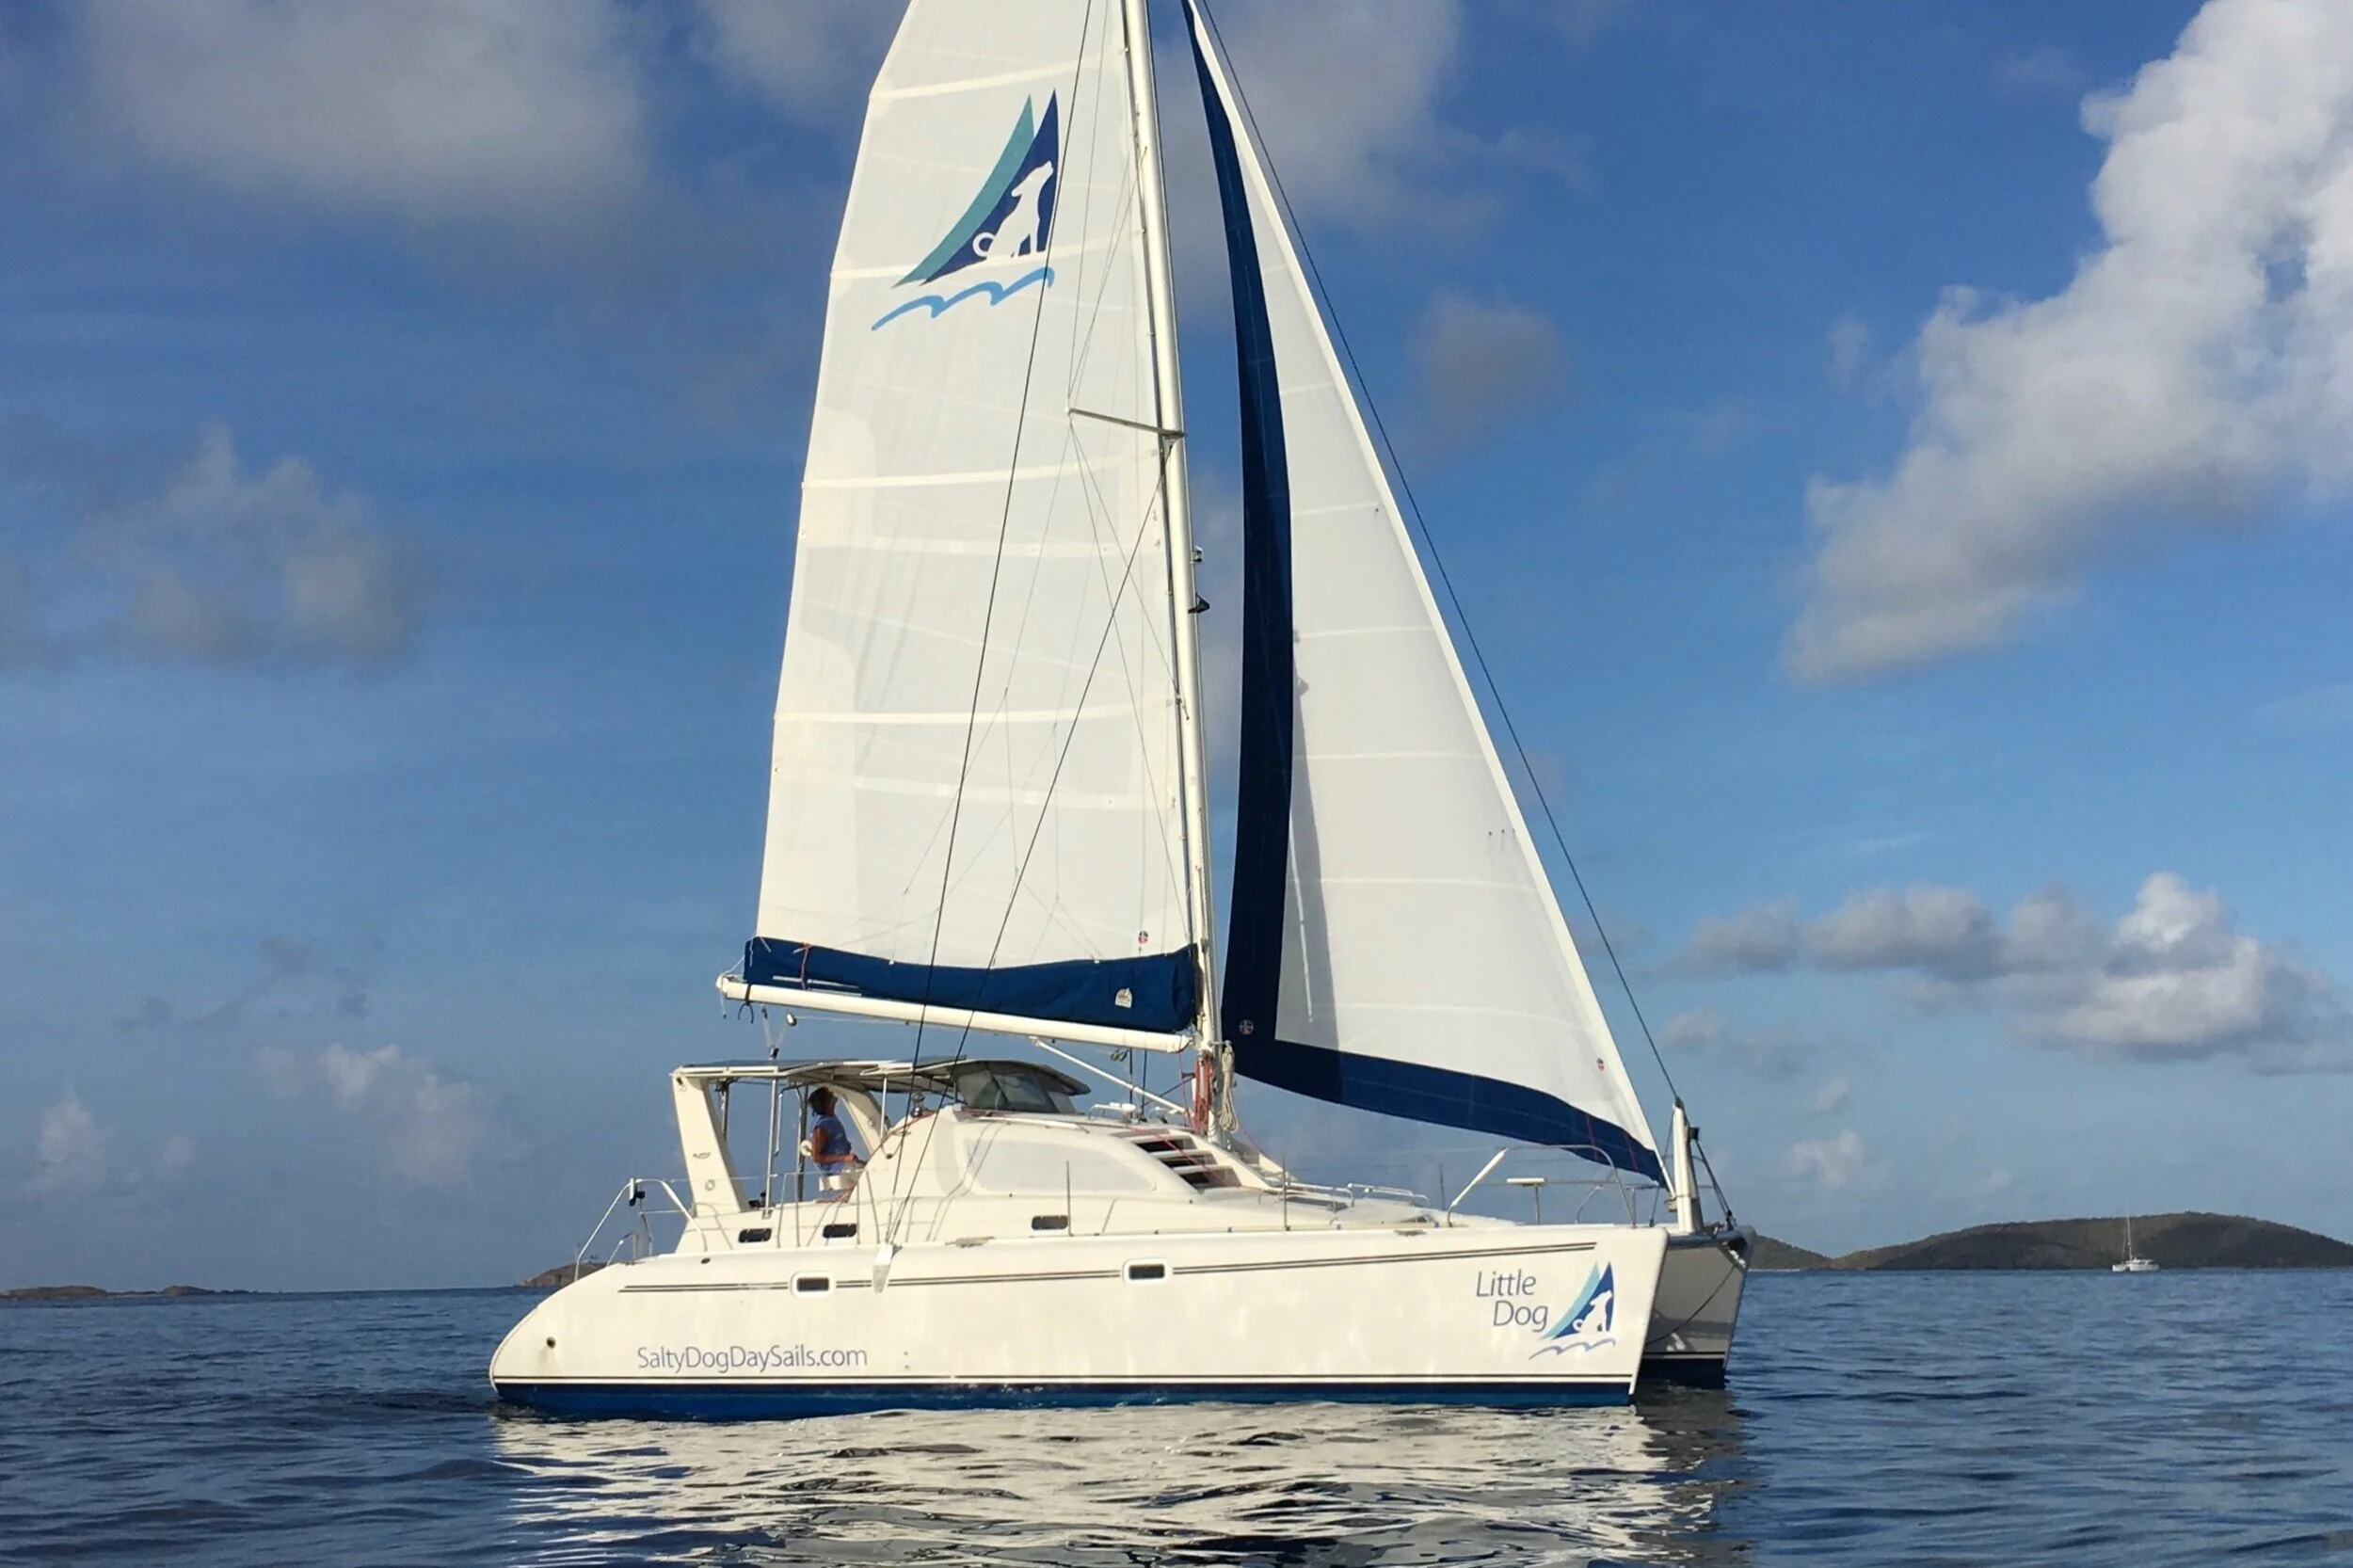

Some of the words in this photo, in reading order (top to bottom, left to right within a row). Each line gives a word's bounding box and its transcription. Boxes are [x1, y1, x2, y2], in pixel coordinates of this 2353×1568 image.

[1476, 1269, 1537, 1297] Little
[1493, 1300, 1548, 1333] Dog
[637, 1344, 868, 1374] SaltyDogDaySails.com
